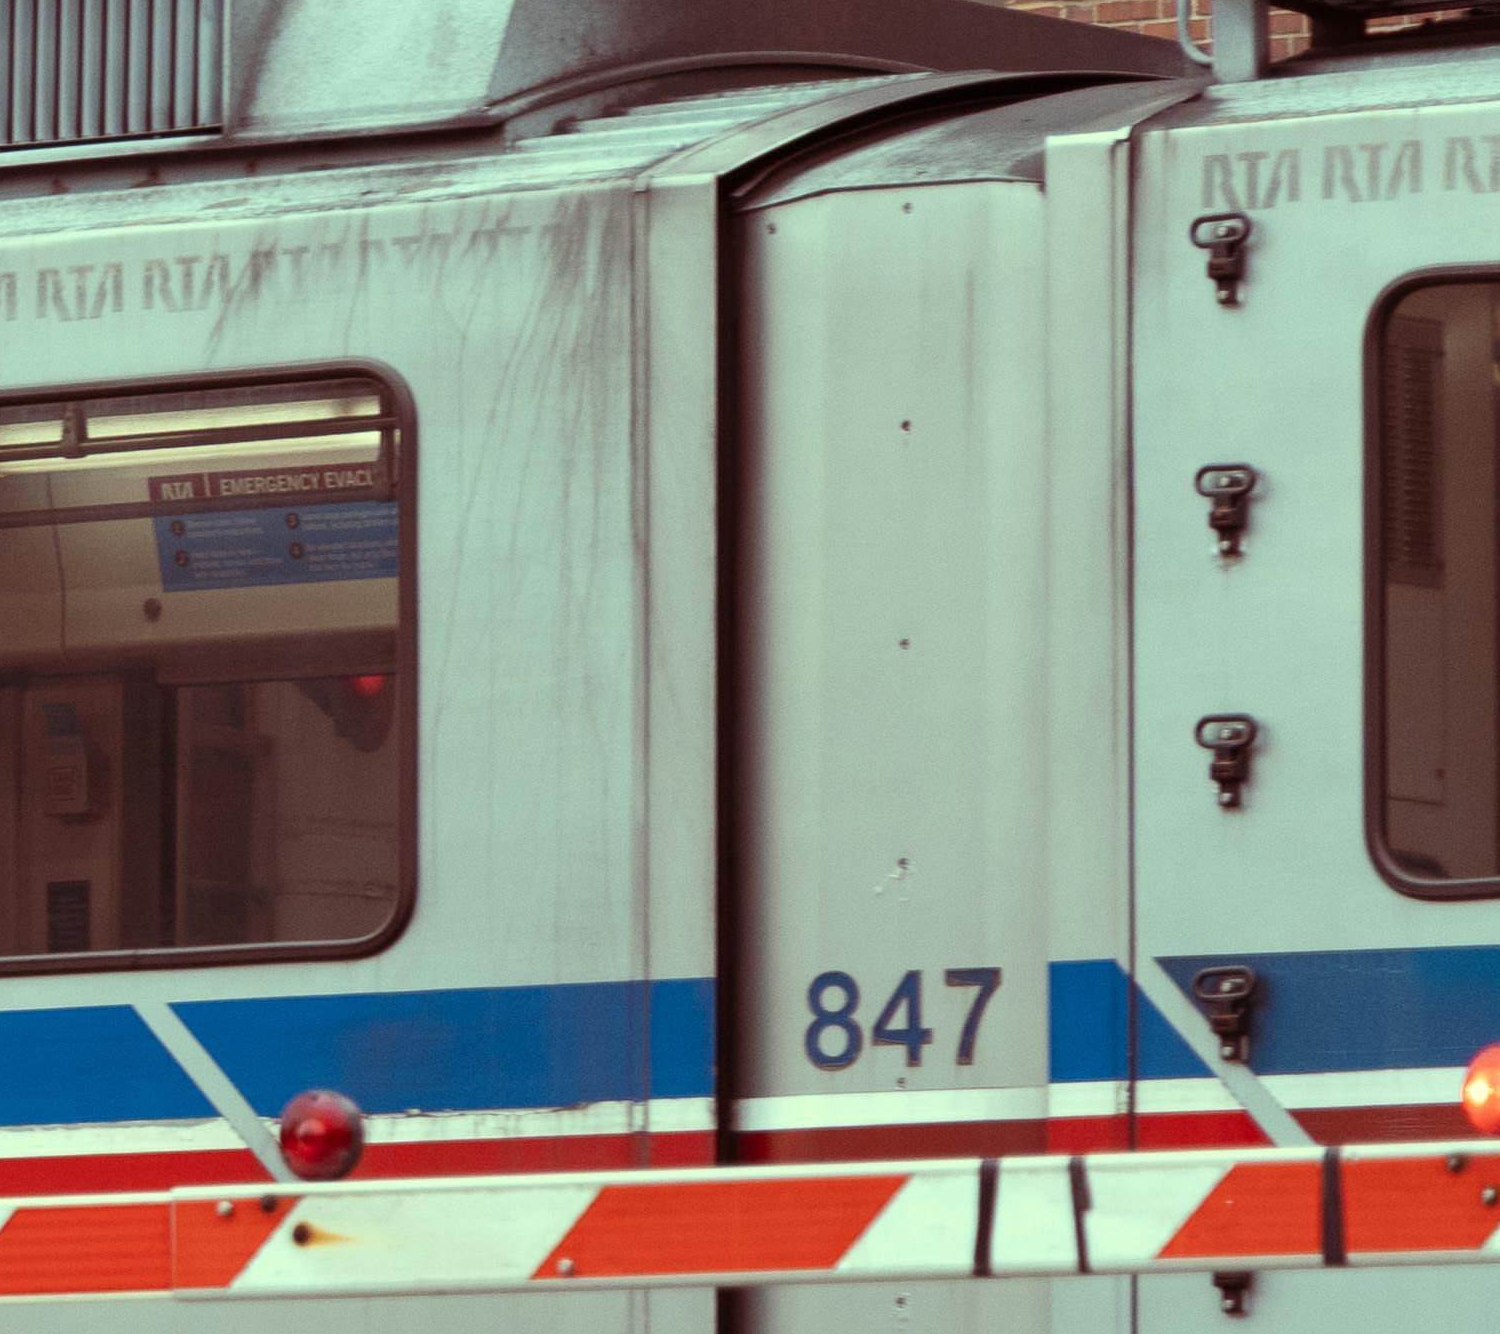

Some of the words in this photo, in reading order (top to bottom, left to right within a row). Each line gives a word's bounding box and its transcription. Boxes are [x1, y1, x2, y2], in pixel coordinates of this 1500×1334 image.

[1202, 149, 1301, 211] RTA
[1322, 139, 1424, 203] RTA
[35, 262, 124, 321] RTA
[142, 253, 231, 312] RTA
[219, 475, 319, 495] EMERGENCY
[803, 966, 1003, 1070] 847
